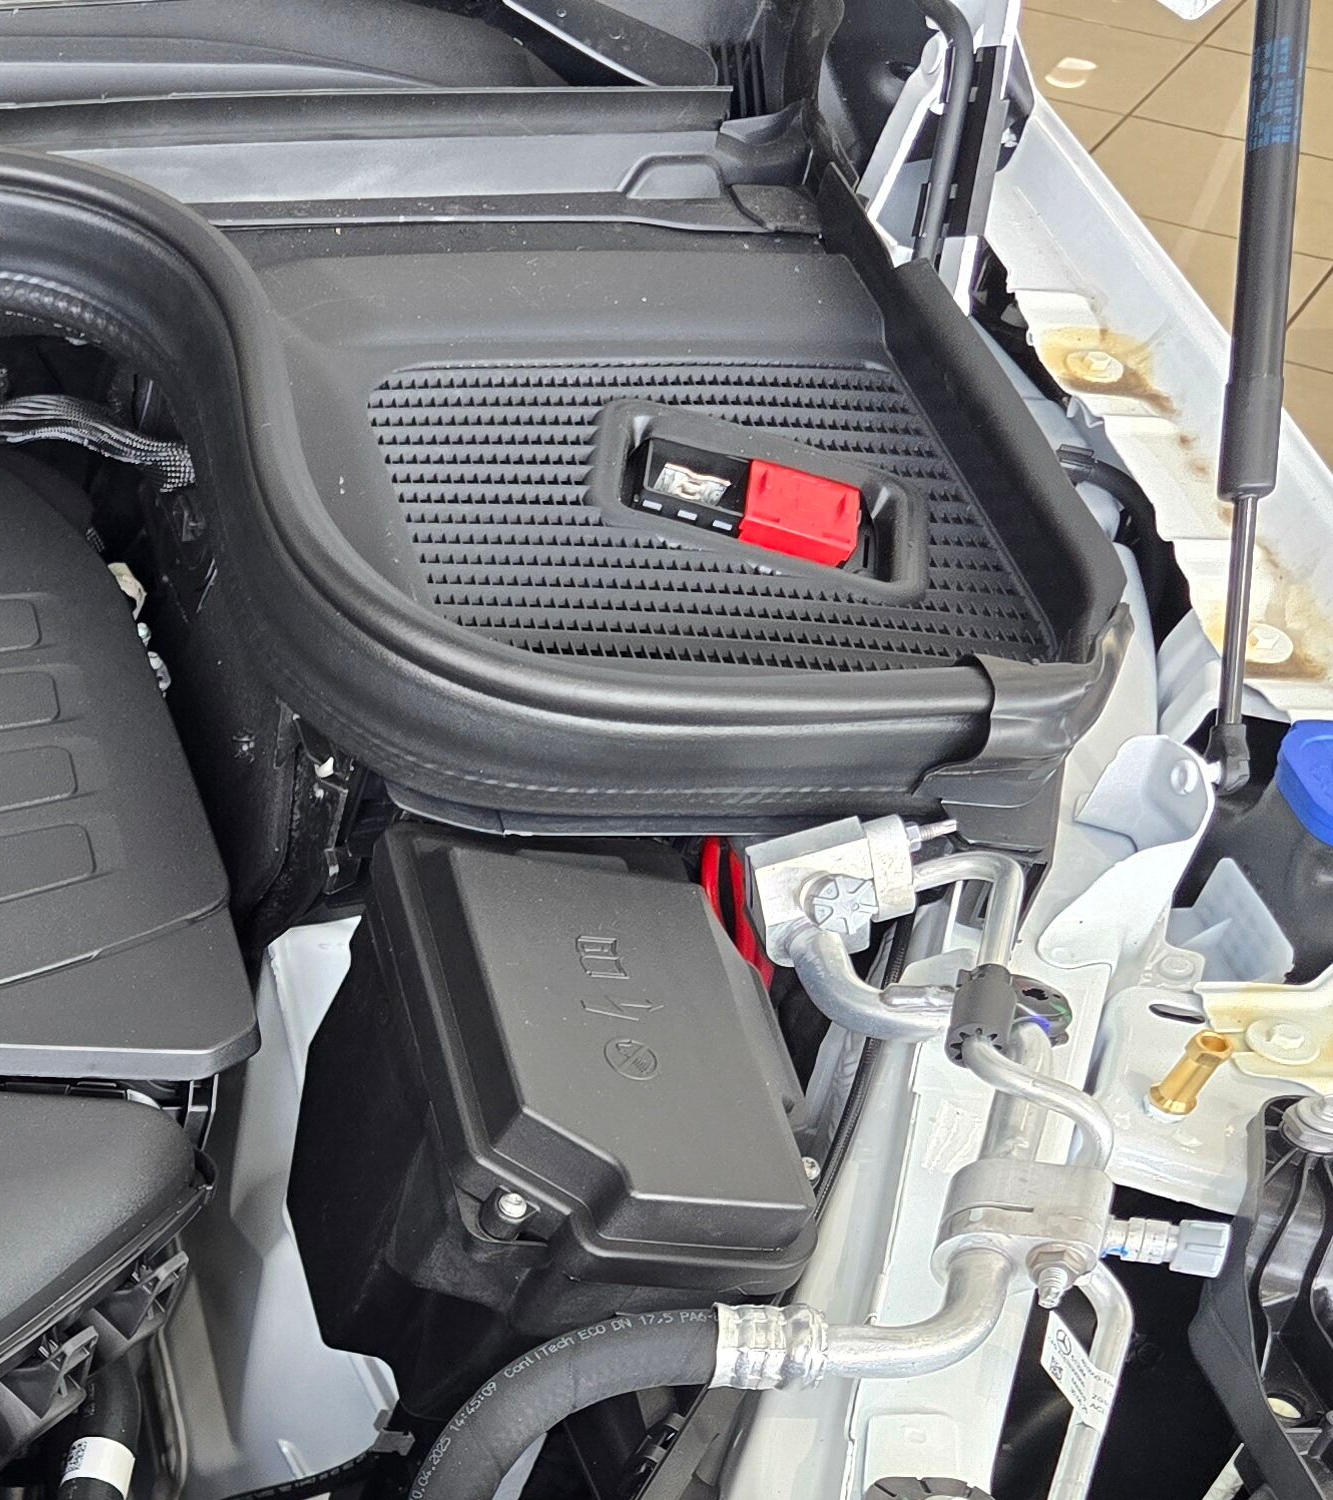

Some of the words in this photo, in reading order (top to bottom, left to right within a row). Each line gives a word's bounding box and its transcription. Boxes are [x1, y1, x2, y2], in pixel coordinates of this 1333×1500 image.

[449, 1381, 497, 1432] 14:45:09
[578, 1325, 606, 1341] ECO
[611, 1317, 633, 1333] DN
